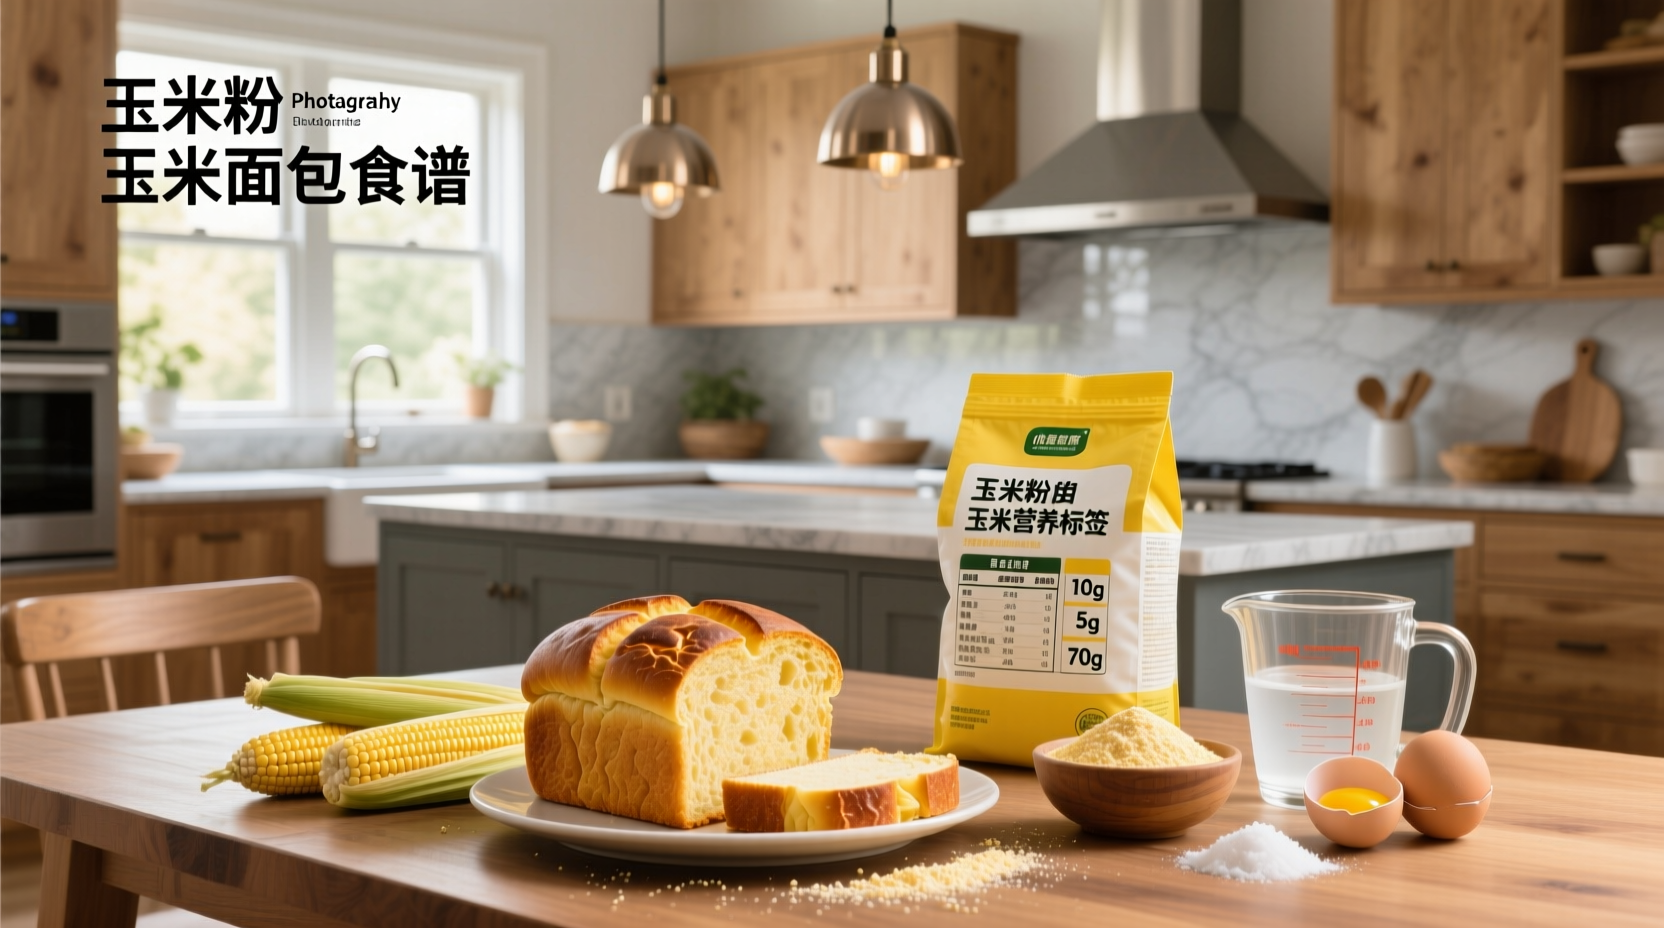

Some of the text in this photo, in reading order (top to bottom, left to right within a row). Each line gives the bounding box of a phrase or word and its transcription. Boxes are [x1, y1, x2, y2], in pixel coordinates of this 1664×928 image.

[965, 507, 1110, 536] 玉米营养标签
[1072, 578, 1105, 602] 10g
[1075, 611, 1100, 635] 5g
[1068, 647, 1103, 672] 70g
